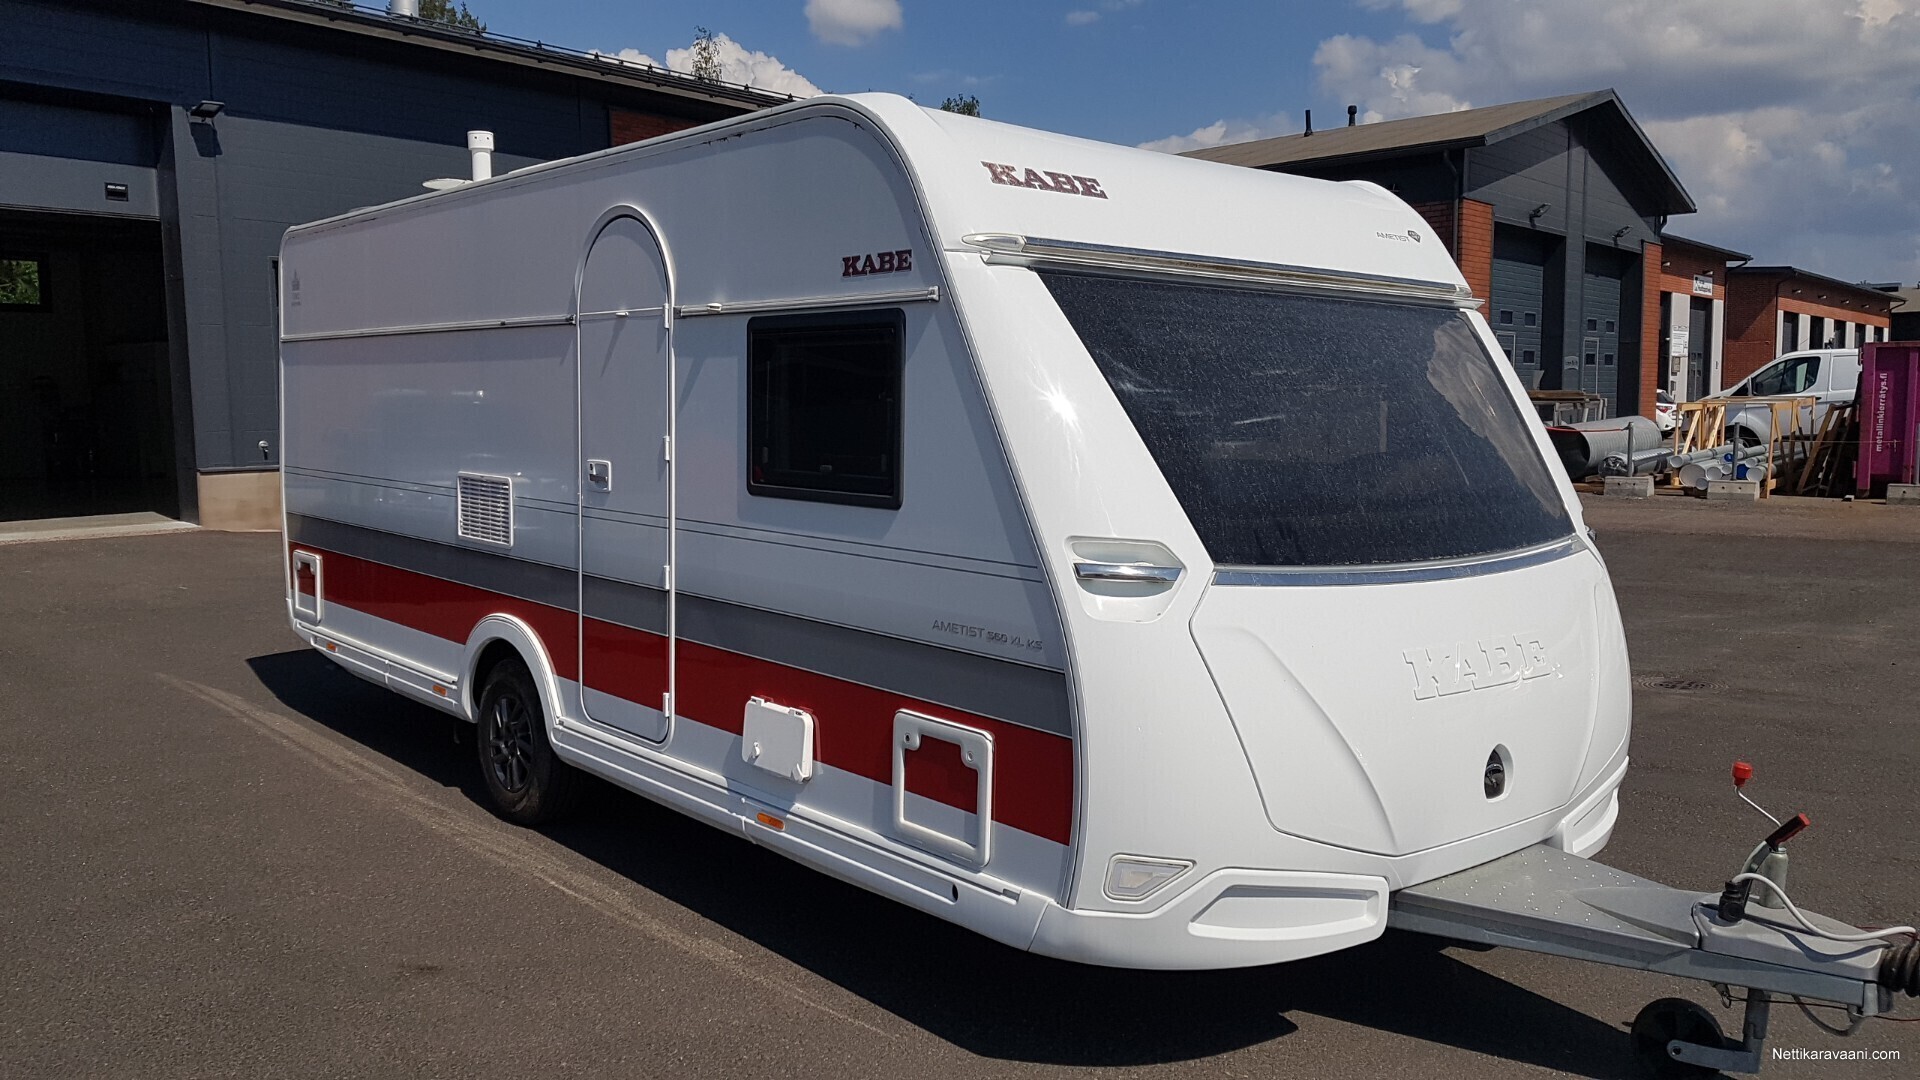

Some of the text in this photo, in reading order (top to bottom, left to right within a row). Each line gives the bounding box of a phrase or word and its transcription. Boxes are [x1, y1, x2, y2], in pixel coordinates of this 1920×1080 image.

[981, 161, 1108, 199] KABE
[842, 250, 912, 277] KABE
[932, 620, 985, 638] AMETIST
[987, 631, 1008, 643] 560
[1025, 639, 1043, 650] KS
[1402, 630, 1555, 701] KABE
